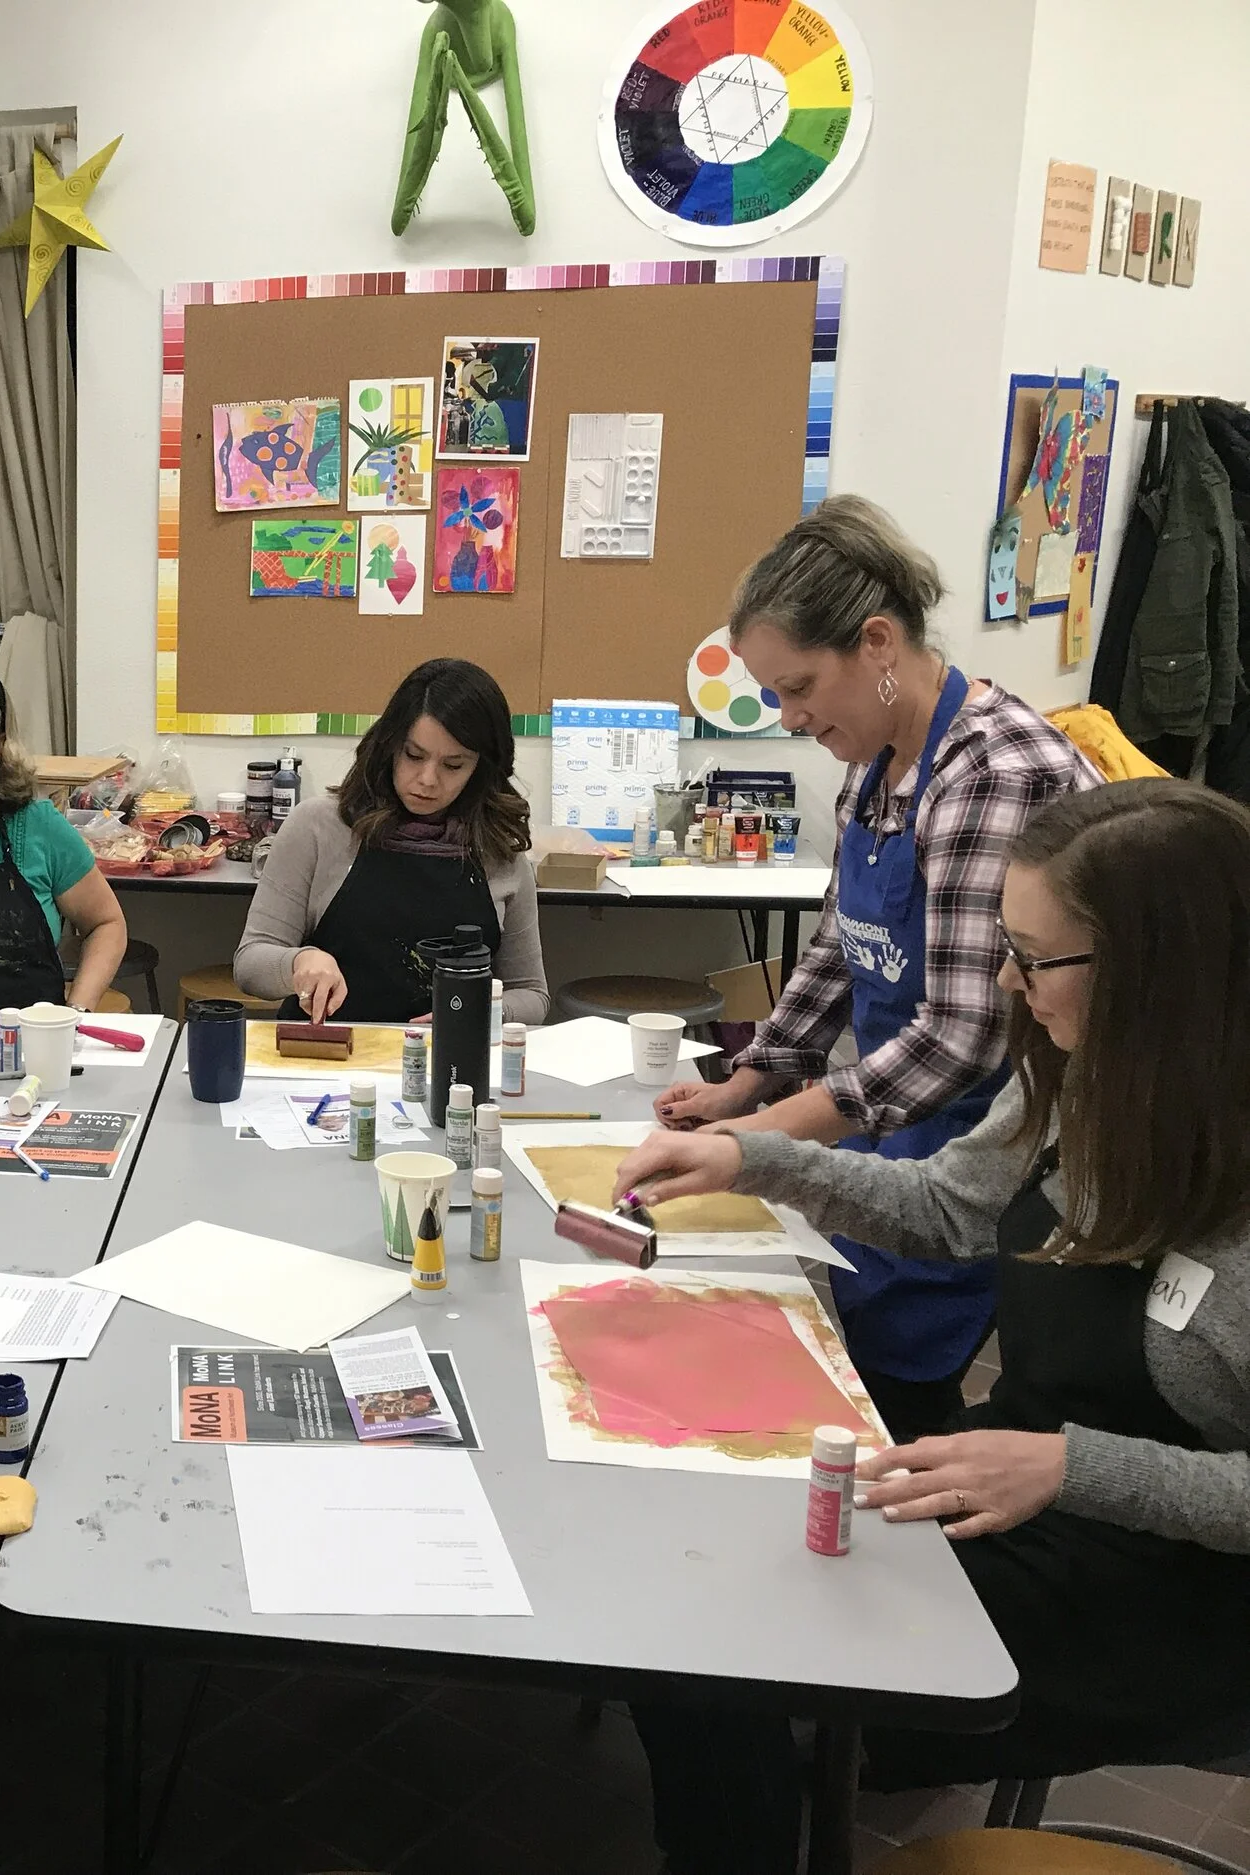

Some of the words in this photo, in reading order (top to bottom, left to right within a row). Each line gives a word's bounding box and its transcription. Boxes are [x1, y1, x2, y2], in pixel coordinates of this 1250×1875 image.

[693, 6, 729, 27] ORANGE
[650, 28, 670, 48] RED
[789, 16, 818, 46] ORANGE
[711, 71, 768, 89] PRIMARY
[833, 55, 850, 92] YELLOW
[628, 71, 650, 110] VIOLET
[823, 119, 839, 144] GREEN
[618, 128, 635, 166] VIOLET
[647, 169, 679, 199] VIOLET
[788, 168, 819, 200] GREEN
[739, 193, 770, 210] GREEN
[693, 210, 718, 223] BLUE
[567, 759, 588, 767] prime
[450, 1064, 458, 1083] Flask
[74, 1120, 121, 1128] LINK
[192, 1355, 210, 1382] MoNA
[217, 1354, 235, 1384] LINK
[189, 1392, 222, 1438] MoNA
[363, 1420, 405, 1432] Classes
